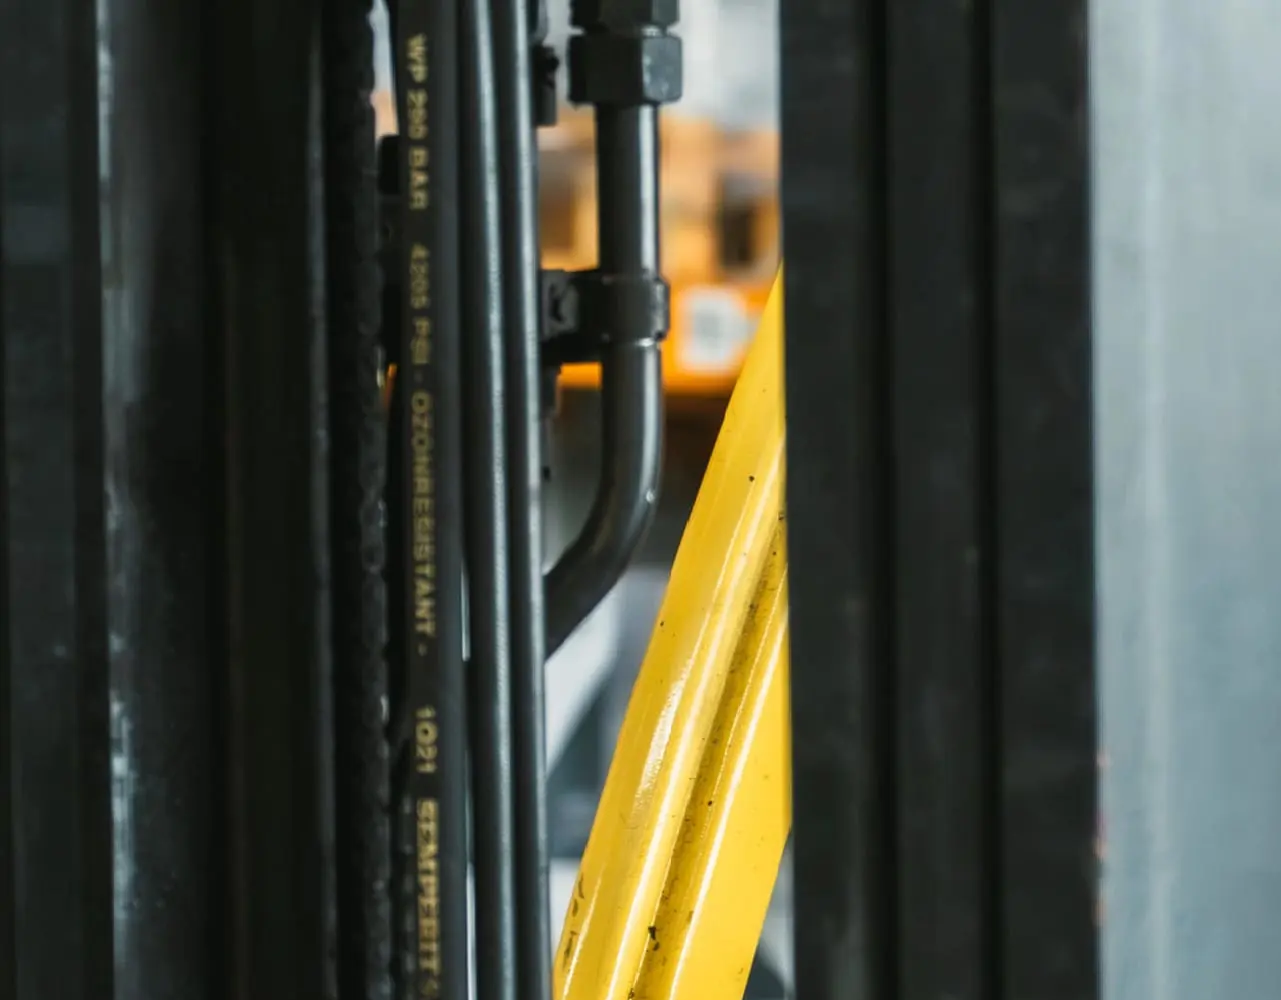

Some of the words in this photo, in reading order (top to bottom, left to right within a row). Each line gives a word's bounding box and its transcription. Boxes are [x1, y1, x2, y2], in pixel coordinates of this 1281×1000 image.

[408, 146, 430, 212] BAR
[411, 390, 434, 637] OZONRESISTANT
[416, 798, 440, 975] SEMPERIT
